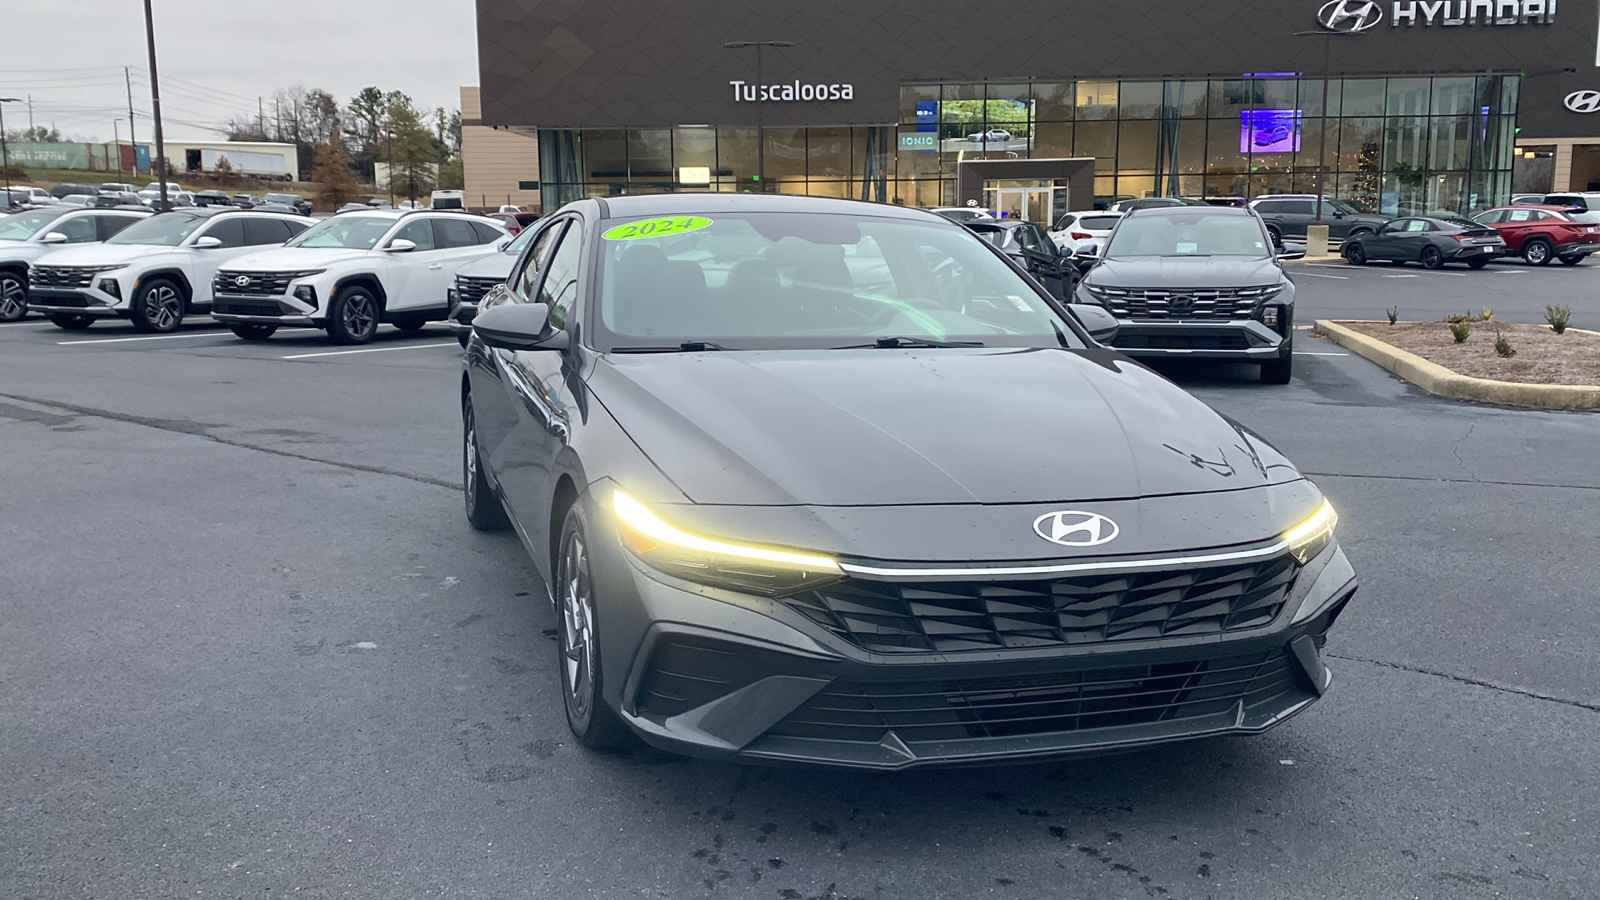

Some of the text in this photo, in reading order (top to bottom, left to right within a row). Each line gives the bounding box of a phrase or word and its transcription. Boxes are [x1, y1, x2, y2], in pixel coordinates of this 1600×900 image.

[1391, 0, 1557, 26] HYUNDAI
[729, 80, 854, 101] Tuscaloosa
[902, 137, 934, 146] IONIQ
[621, 217, 694, 239] 2024
